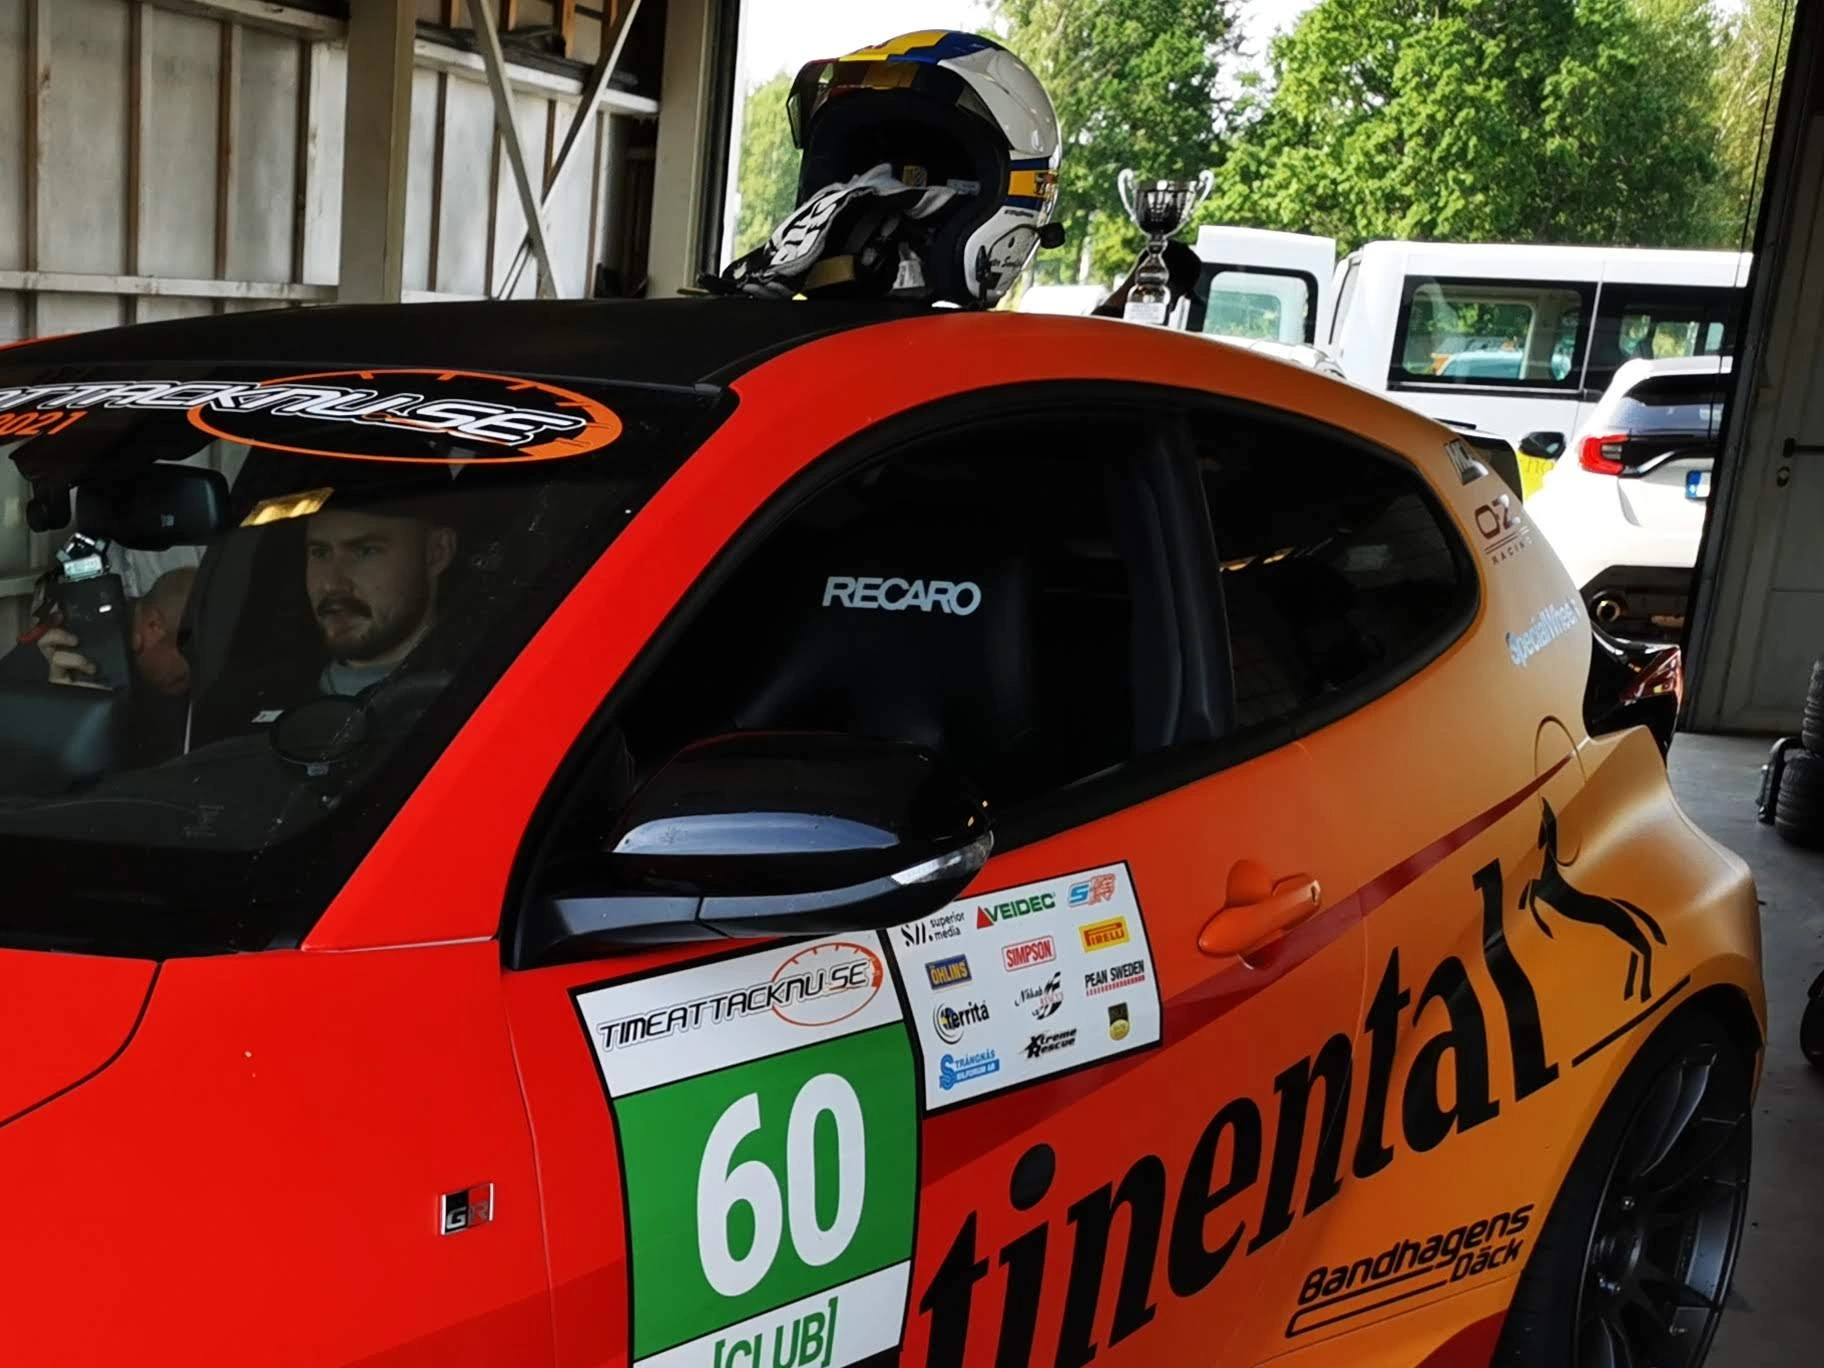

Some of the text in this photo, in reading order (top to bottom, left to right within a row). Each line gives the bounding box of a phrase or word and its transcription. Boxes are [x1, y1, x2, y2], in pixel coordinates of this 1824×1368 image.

[822, 576, 982, 616] RECARO
[930, 911, 965, 928] superior
[984, 893, 1056, 922] VEIDEC
[934, 925, 961, 941] media
[1083, 921, 1125, 947] PIRELLI
[1005, 939, 1052, 968] SIMPSON
[1084, 960, 1145, 989] PEAN SWEDEN
[697, 1072, 866, 1297] 60
[1297, 1203, 1535, 1305] Bandhagens
[1449, 1239, 1524, 1283] Däck
